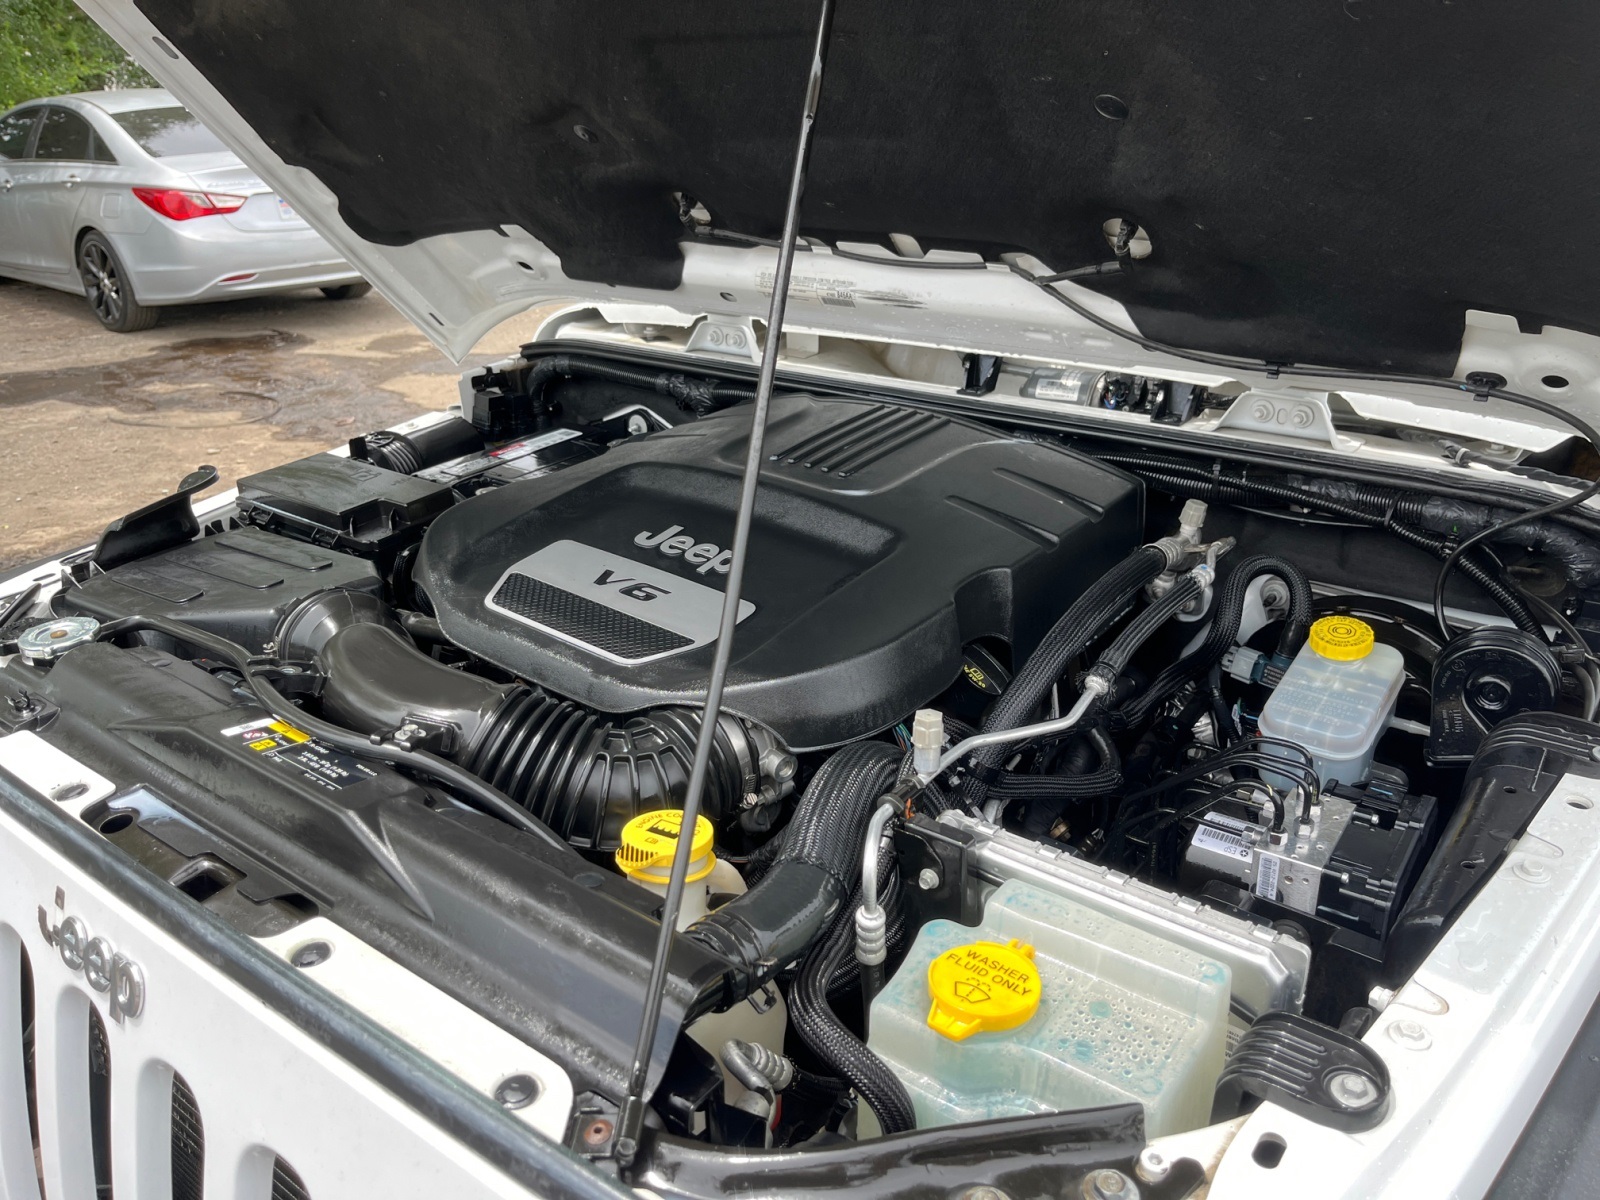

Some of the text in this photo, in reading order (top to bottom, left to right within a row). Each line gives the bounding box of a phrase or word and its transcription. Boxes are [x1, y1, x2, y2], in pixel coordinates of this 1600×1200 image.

[633, 524, 735, 575] Jeep
[593, 569, 672, 602] V6
[37, 885, 146, 1025] Jeep
[945, 952, 1033, 997] FLUID ONLY
[965, 949, 1030, 984] WASHER
